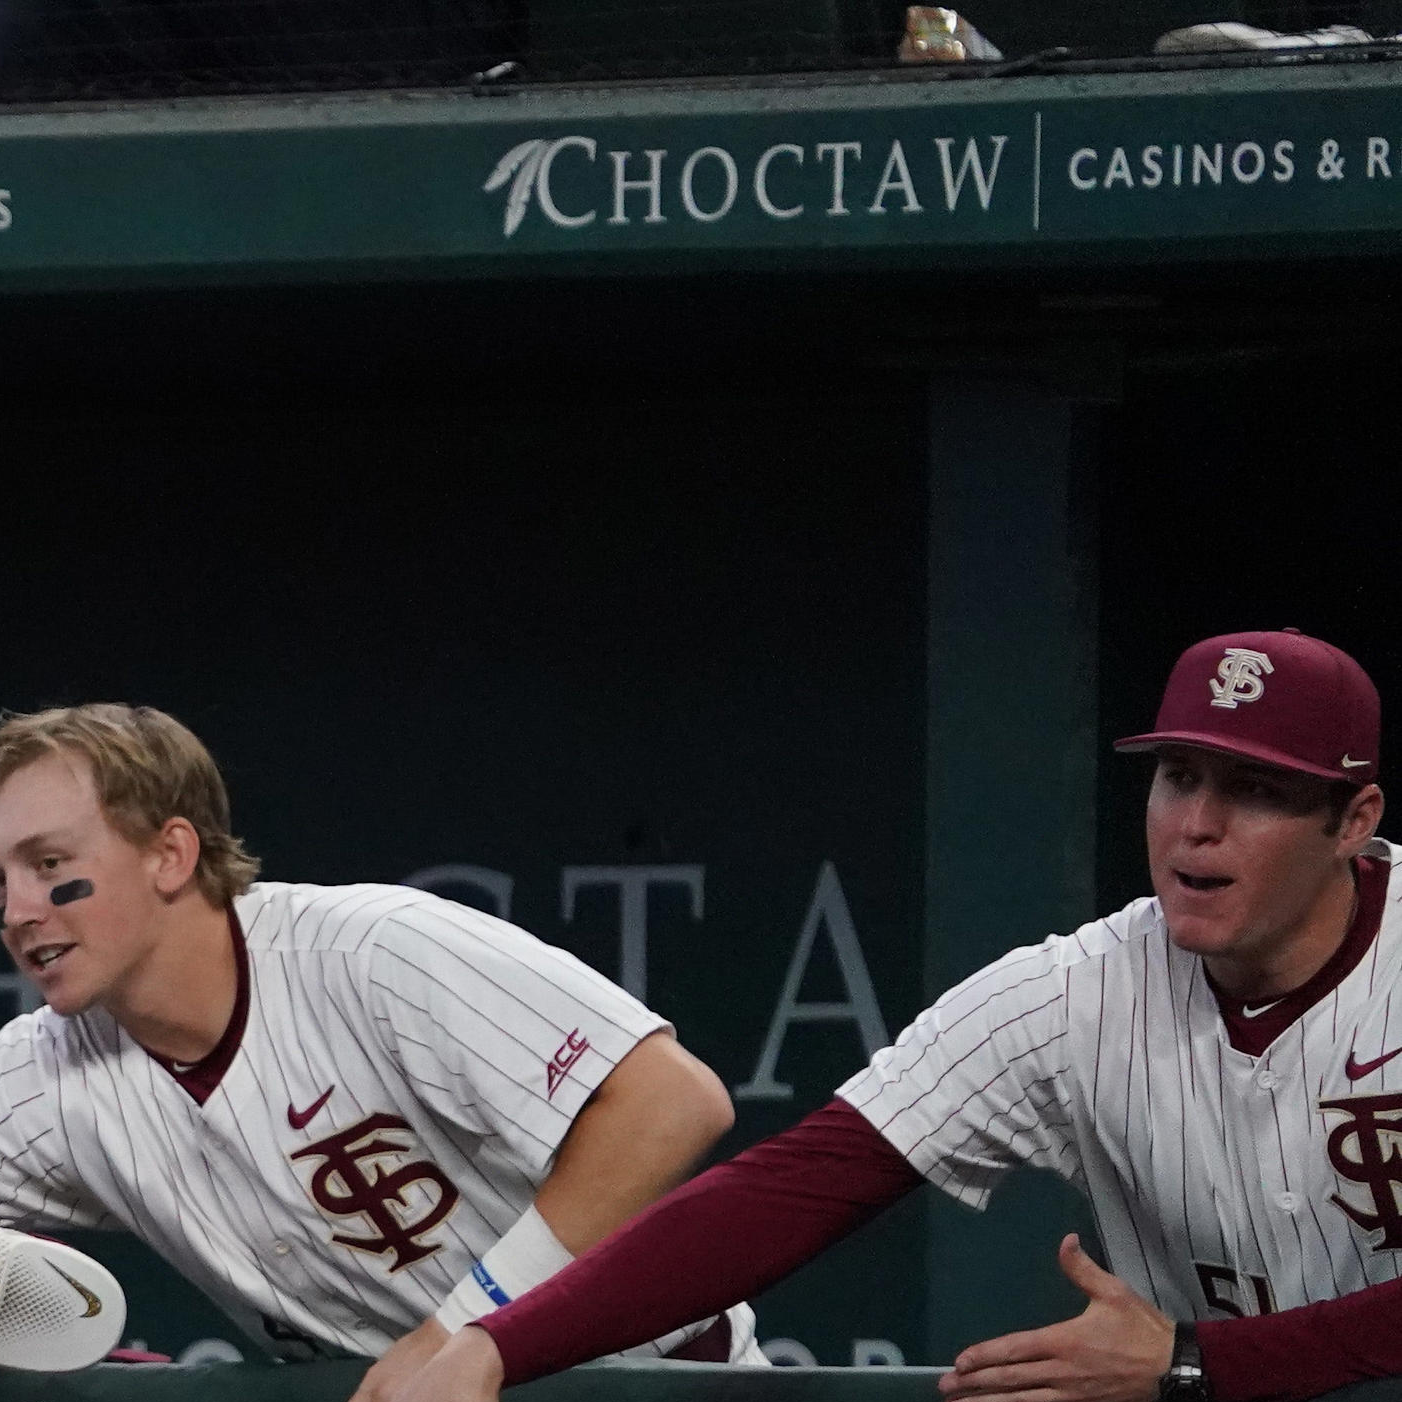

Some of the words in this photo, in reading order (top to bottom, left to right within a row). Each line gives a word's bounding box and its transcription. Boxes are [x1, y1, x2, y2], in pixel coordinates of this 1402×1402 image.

[536, 136, 1007, 228] CHOCTAW
[1069, 141, 1294, 189] CASINOS
[1317, 139, 1344, 180] &
[547, 1027, 590, 1101] ACC
